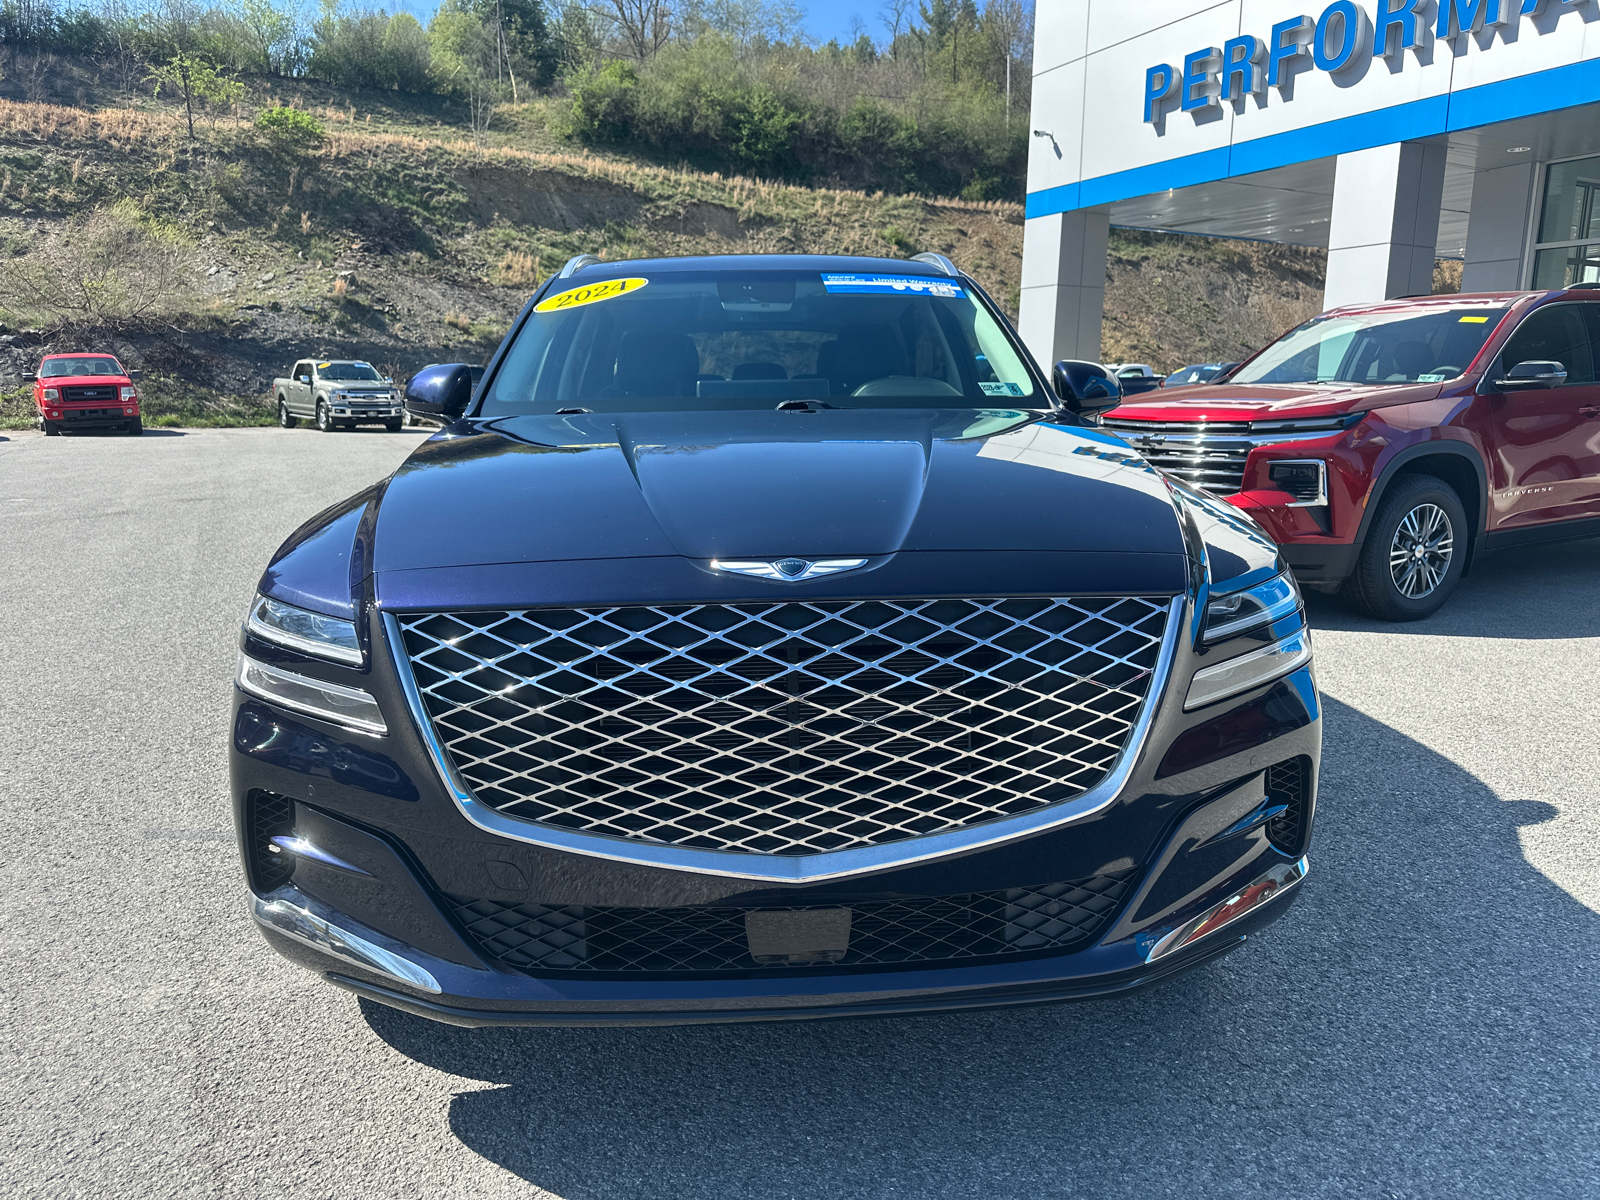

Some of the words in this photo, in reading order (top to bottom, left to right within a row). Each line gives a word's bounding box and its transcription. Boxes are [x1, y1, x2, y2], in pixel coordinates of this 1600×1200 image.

[1143, 0, 1590, 124] PERFOR
[908, 279, 952, 287] Warranty
[556, 281, 629, 308] 2024
[1502, 486, 1554, 498] TRAVERSE
